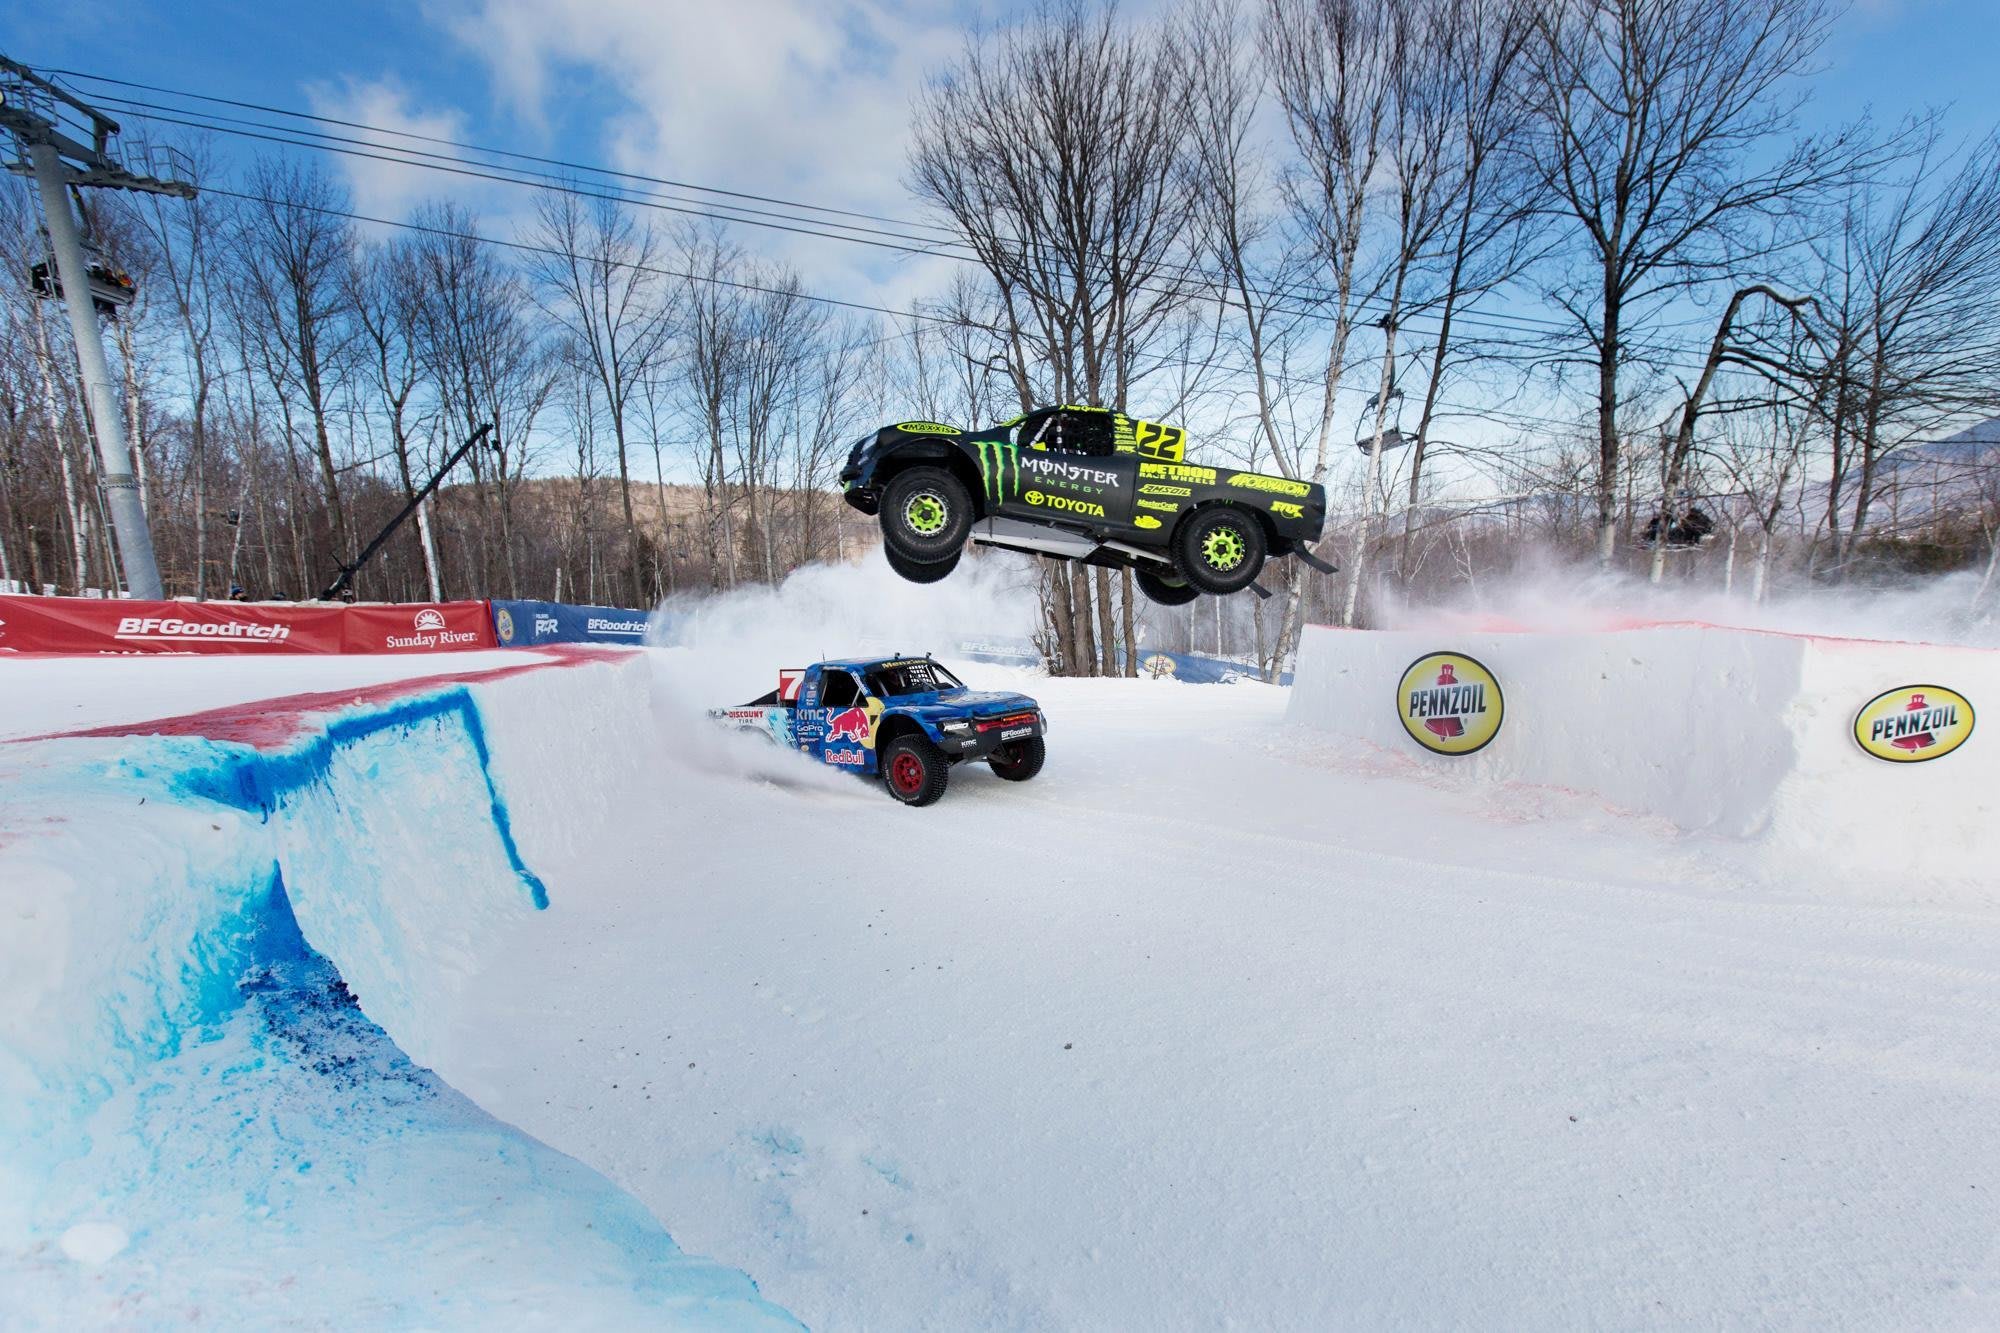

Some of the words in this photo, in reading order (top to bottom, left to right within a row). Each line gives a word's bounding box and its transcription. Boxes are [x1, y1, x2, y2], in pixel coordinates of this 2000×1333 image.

[908, 424, 952, 434] MAXXIS
[1139, 423, 1182, 459] 22
[1021, 457, 1120, 488] MONSTER
[1140, 463, 1217, 480] METHOD
[1171, 475, 1216, 486] WHEELS
[1034, 476, 1104, 495] ENERGY
[1144, 485, 1190, 497] AMSOIL
[1046, 494, 1105, 518] TOYOTA
[117, 618, 291, 639] BFGoodrich
[386, 632, 437, 649] Sunday
[439, 630, 477, 644] River
[781, 670, 806, 700] 7
[1409, 684, 1487, 718] PENNZOIL
[729, 710, 763, 718] DISCOUNT
[1871, 704, 1959, 742] PENNZOIL
[825, 749, 845, 764] Red
[845, 749, 864, 765] Bull
